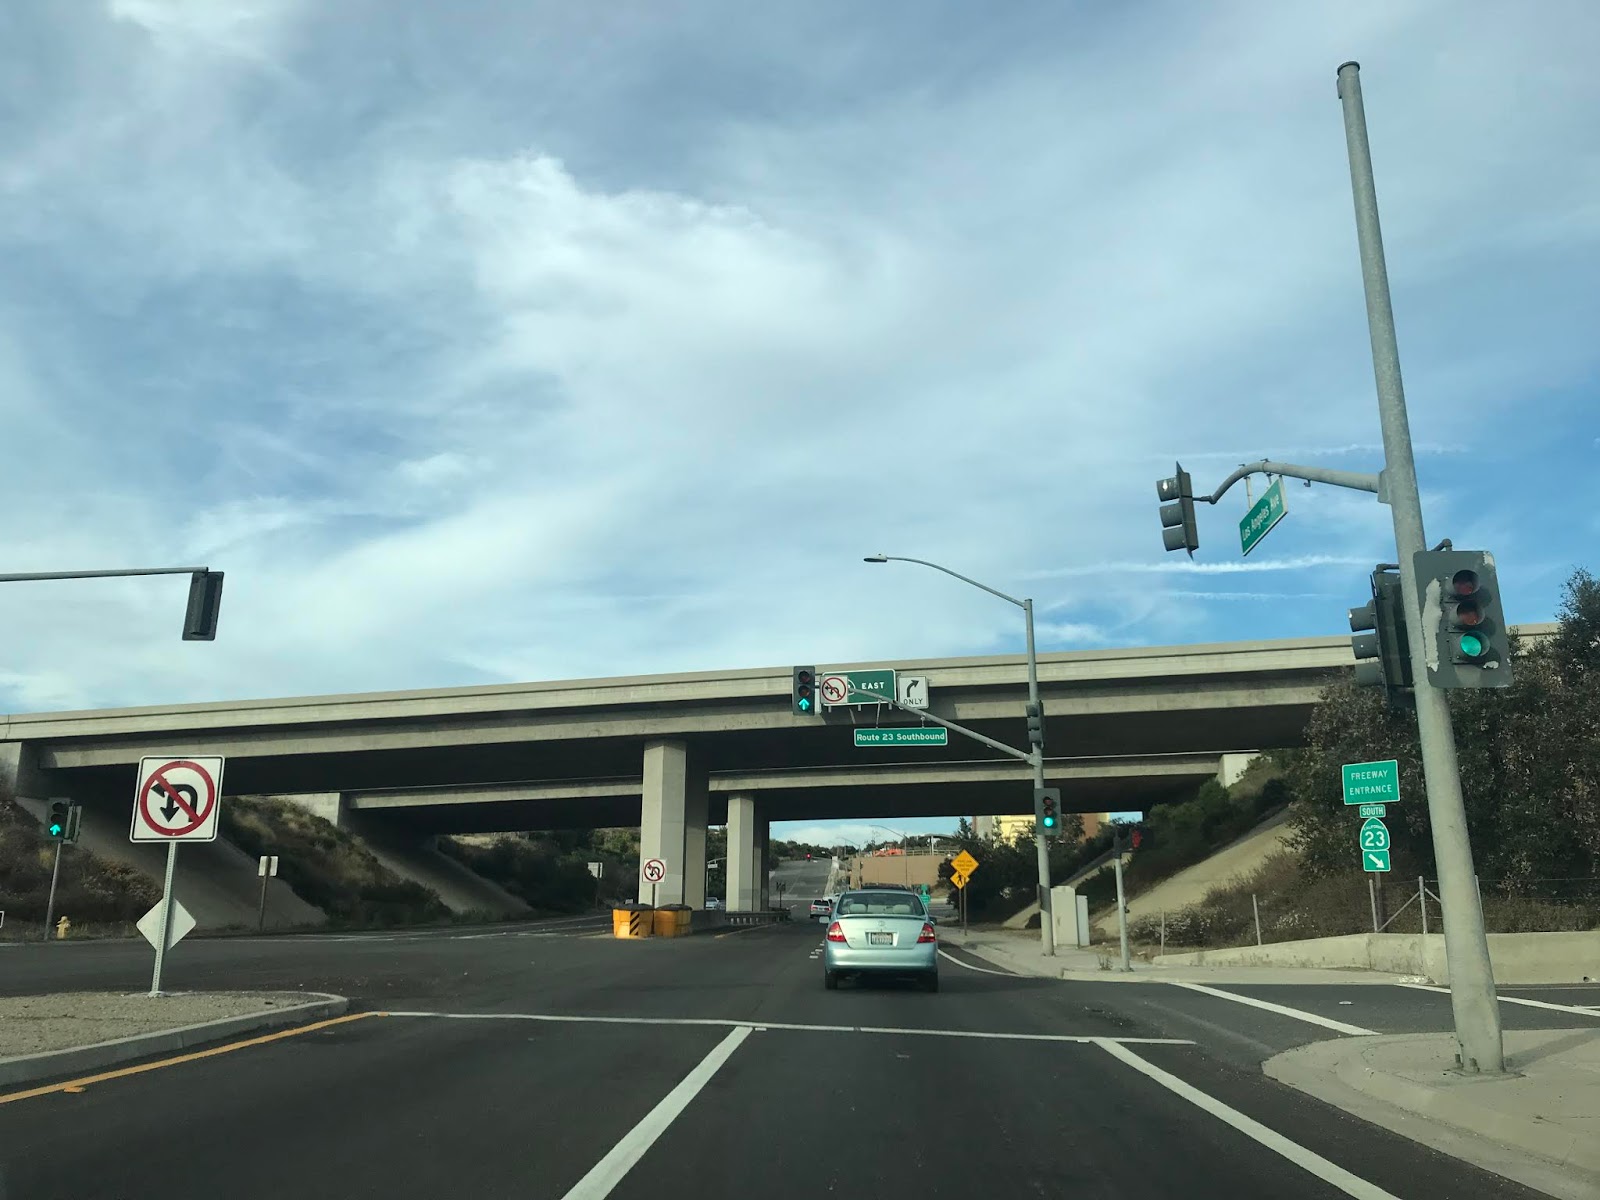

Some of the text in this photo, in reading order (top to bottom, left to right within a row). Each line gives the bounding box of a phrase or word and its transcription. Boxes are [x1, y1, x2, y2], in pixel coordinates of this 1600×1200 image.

[1242, 526, 1251, 541] Los
[1251, 505, 1270, 532] Angeles
[861, 681, 885, 690] EAST
[903, 698, 924, 706] ONLY
[856, 732, 945, 741] Route 23 Southbound
[1351, 770, 1388, 780] FREEWAY
[1350, 784, 1393, 796] ENTRANCE
[1361, 806, 1384, 816] SOUTH
[1364, 830, 1385, 847] 23
